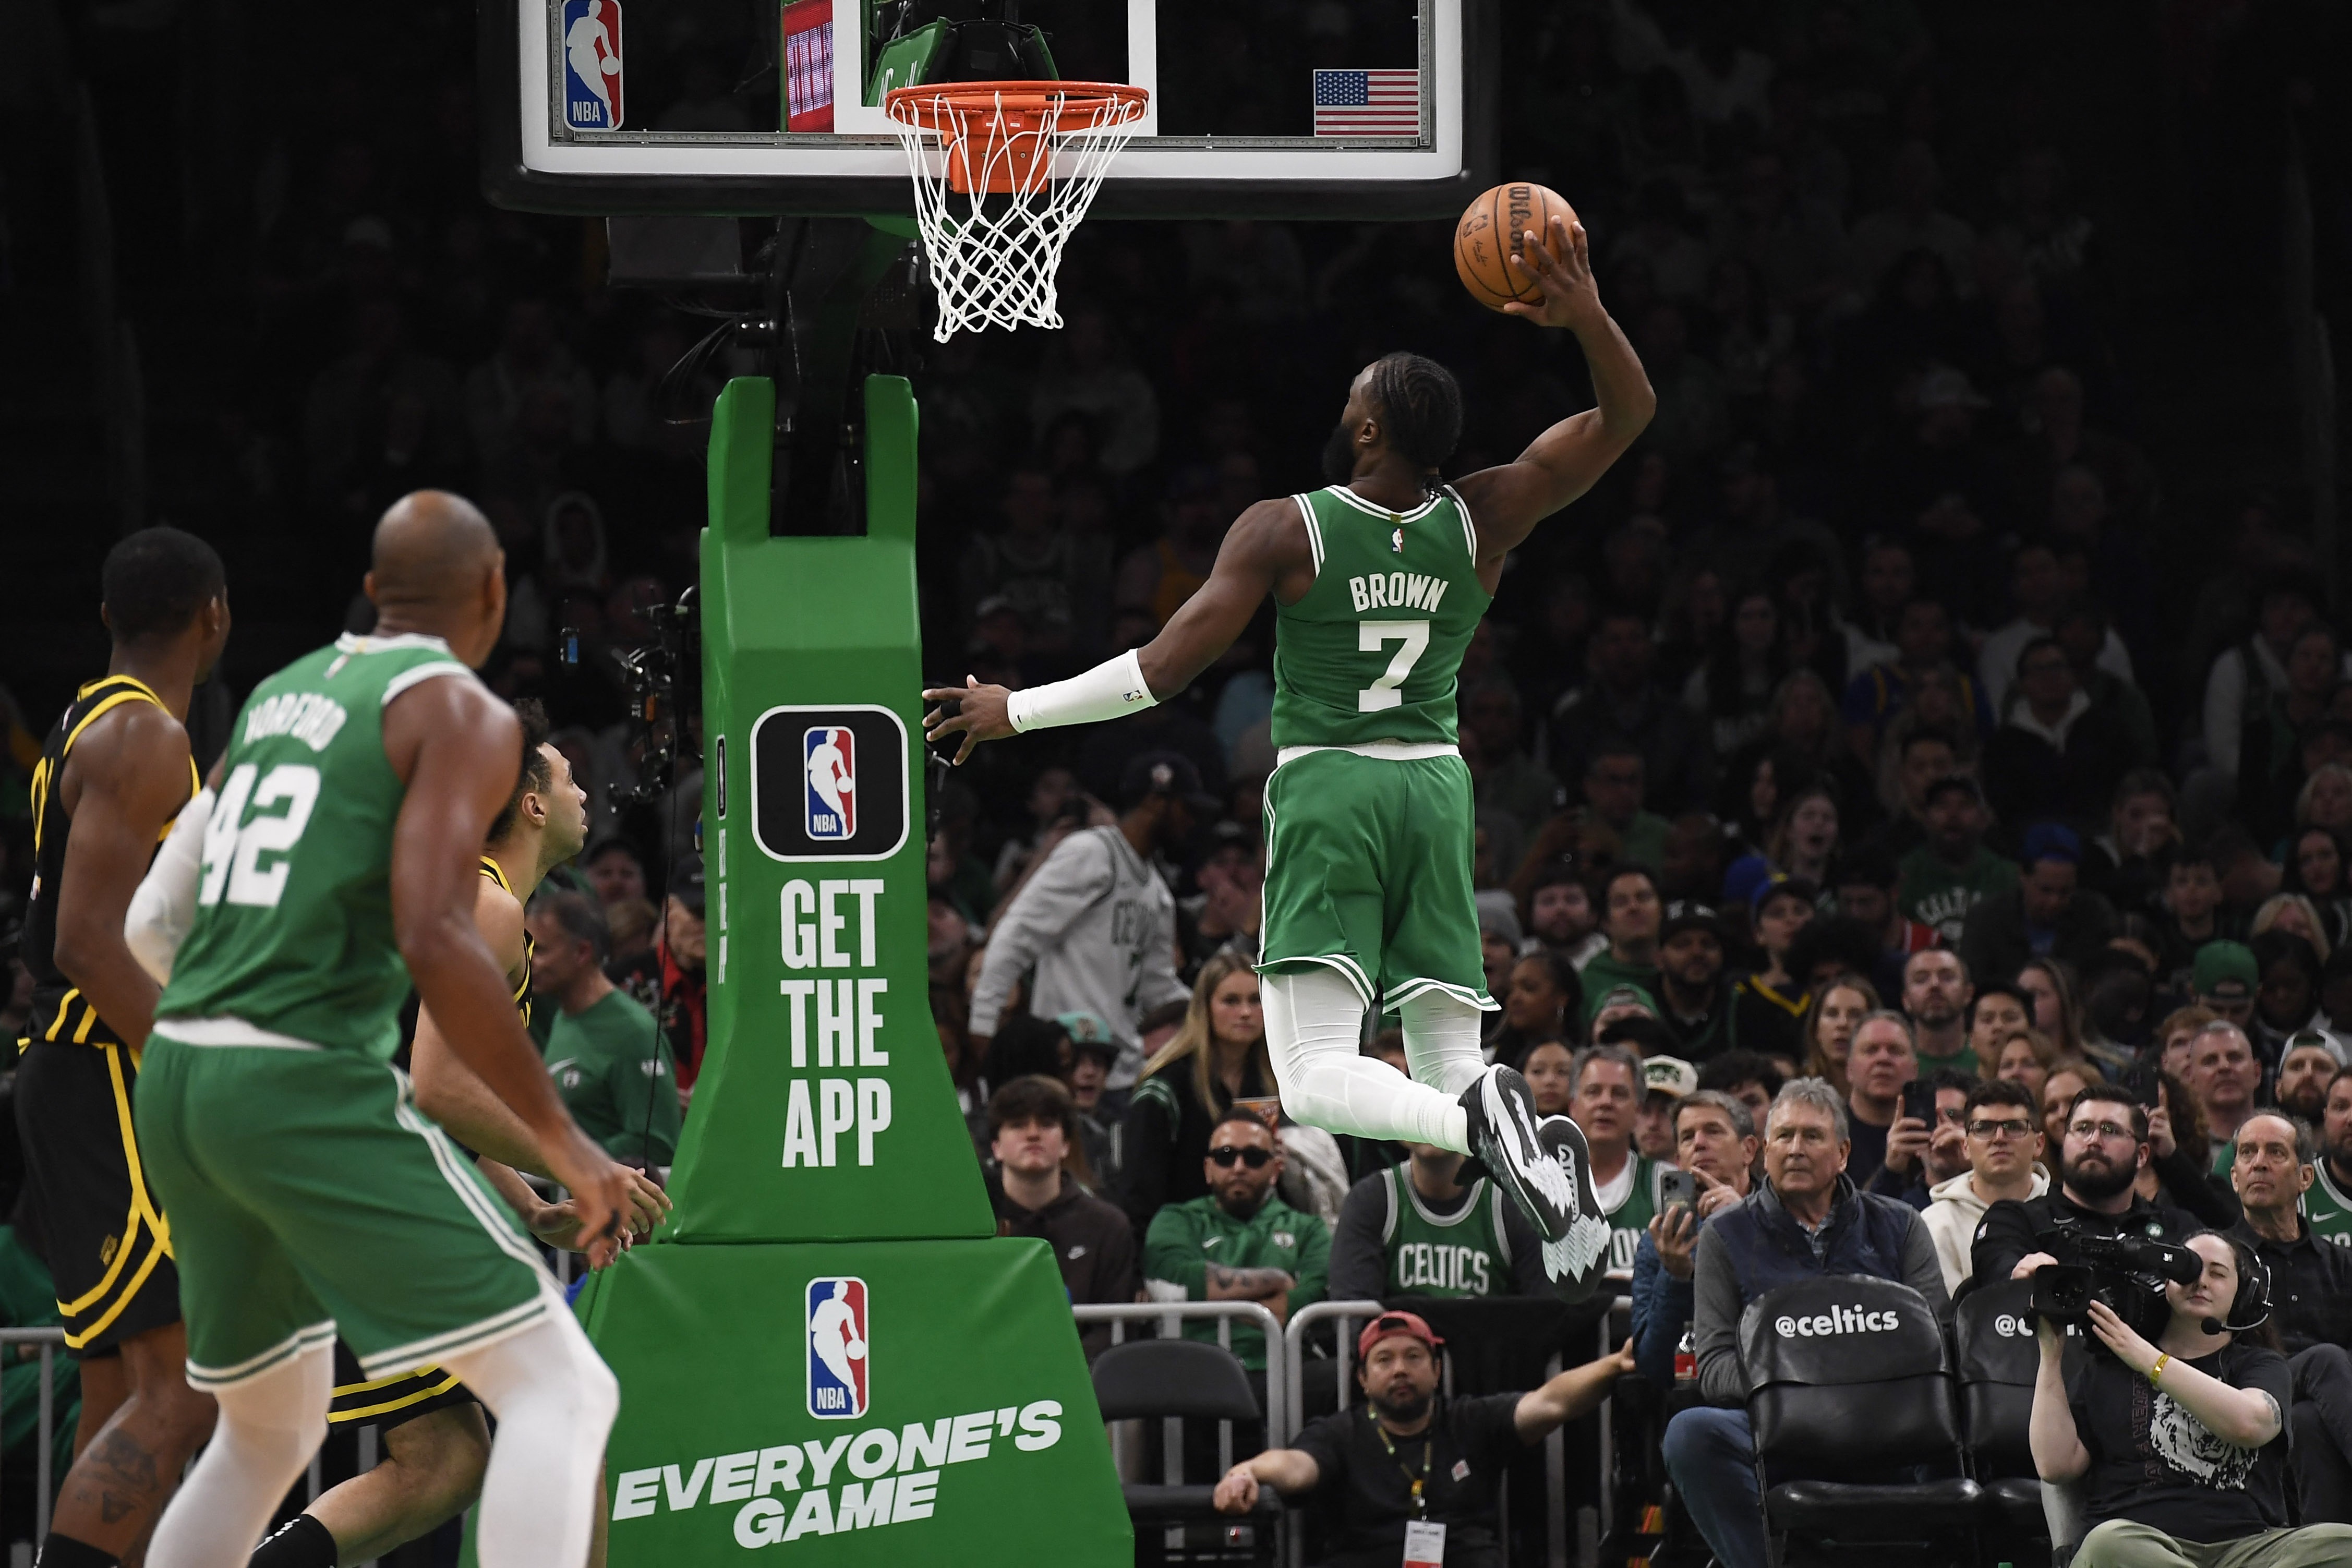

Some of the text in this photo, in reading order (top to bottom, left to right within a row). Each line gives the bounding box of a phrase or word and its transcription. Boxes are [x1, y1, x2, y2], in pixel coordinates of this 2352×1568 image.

[572, 101, 601, 123] NBA
[1348, 571, 1450, 613] BROWN
[1358, 619, 1430, 713] 7
[243, 692, 348, 752] HORFORD
[198, 763, 322, 908] 42
[813, 813, 837, 833] NBA
[780, 878, 885, 969] GET
[780, 978, 890, 1068] THE
[781, 1078, 892, 1168] APP
[1398, 1242, 1491, 1295] CELTICS
[1775, 1303, 1900, 1338] @celtics
[815, 1386, 846, 1410] NBA
[611, 1400, 1063, 1522] EVERYONE'S
[733, 1469, 941, 1550] GAME
